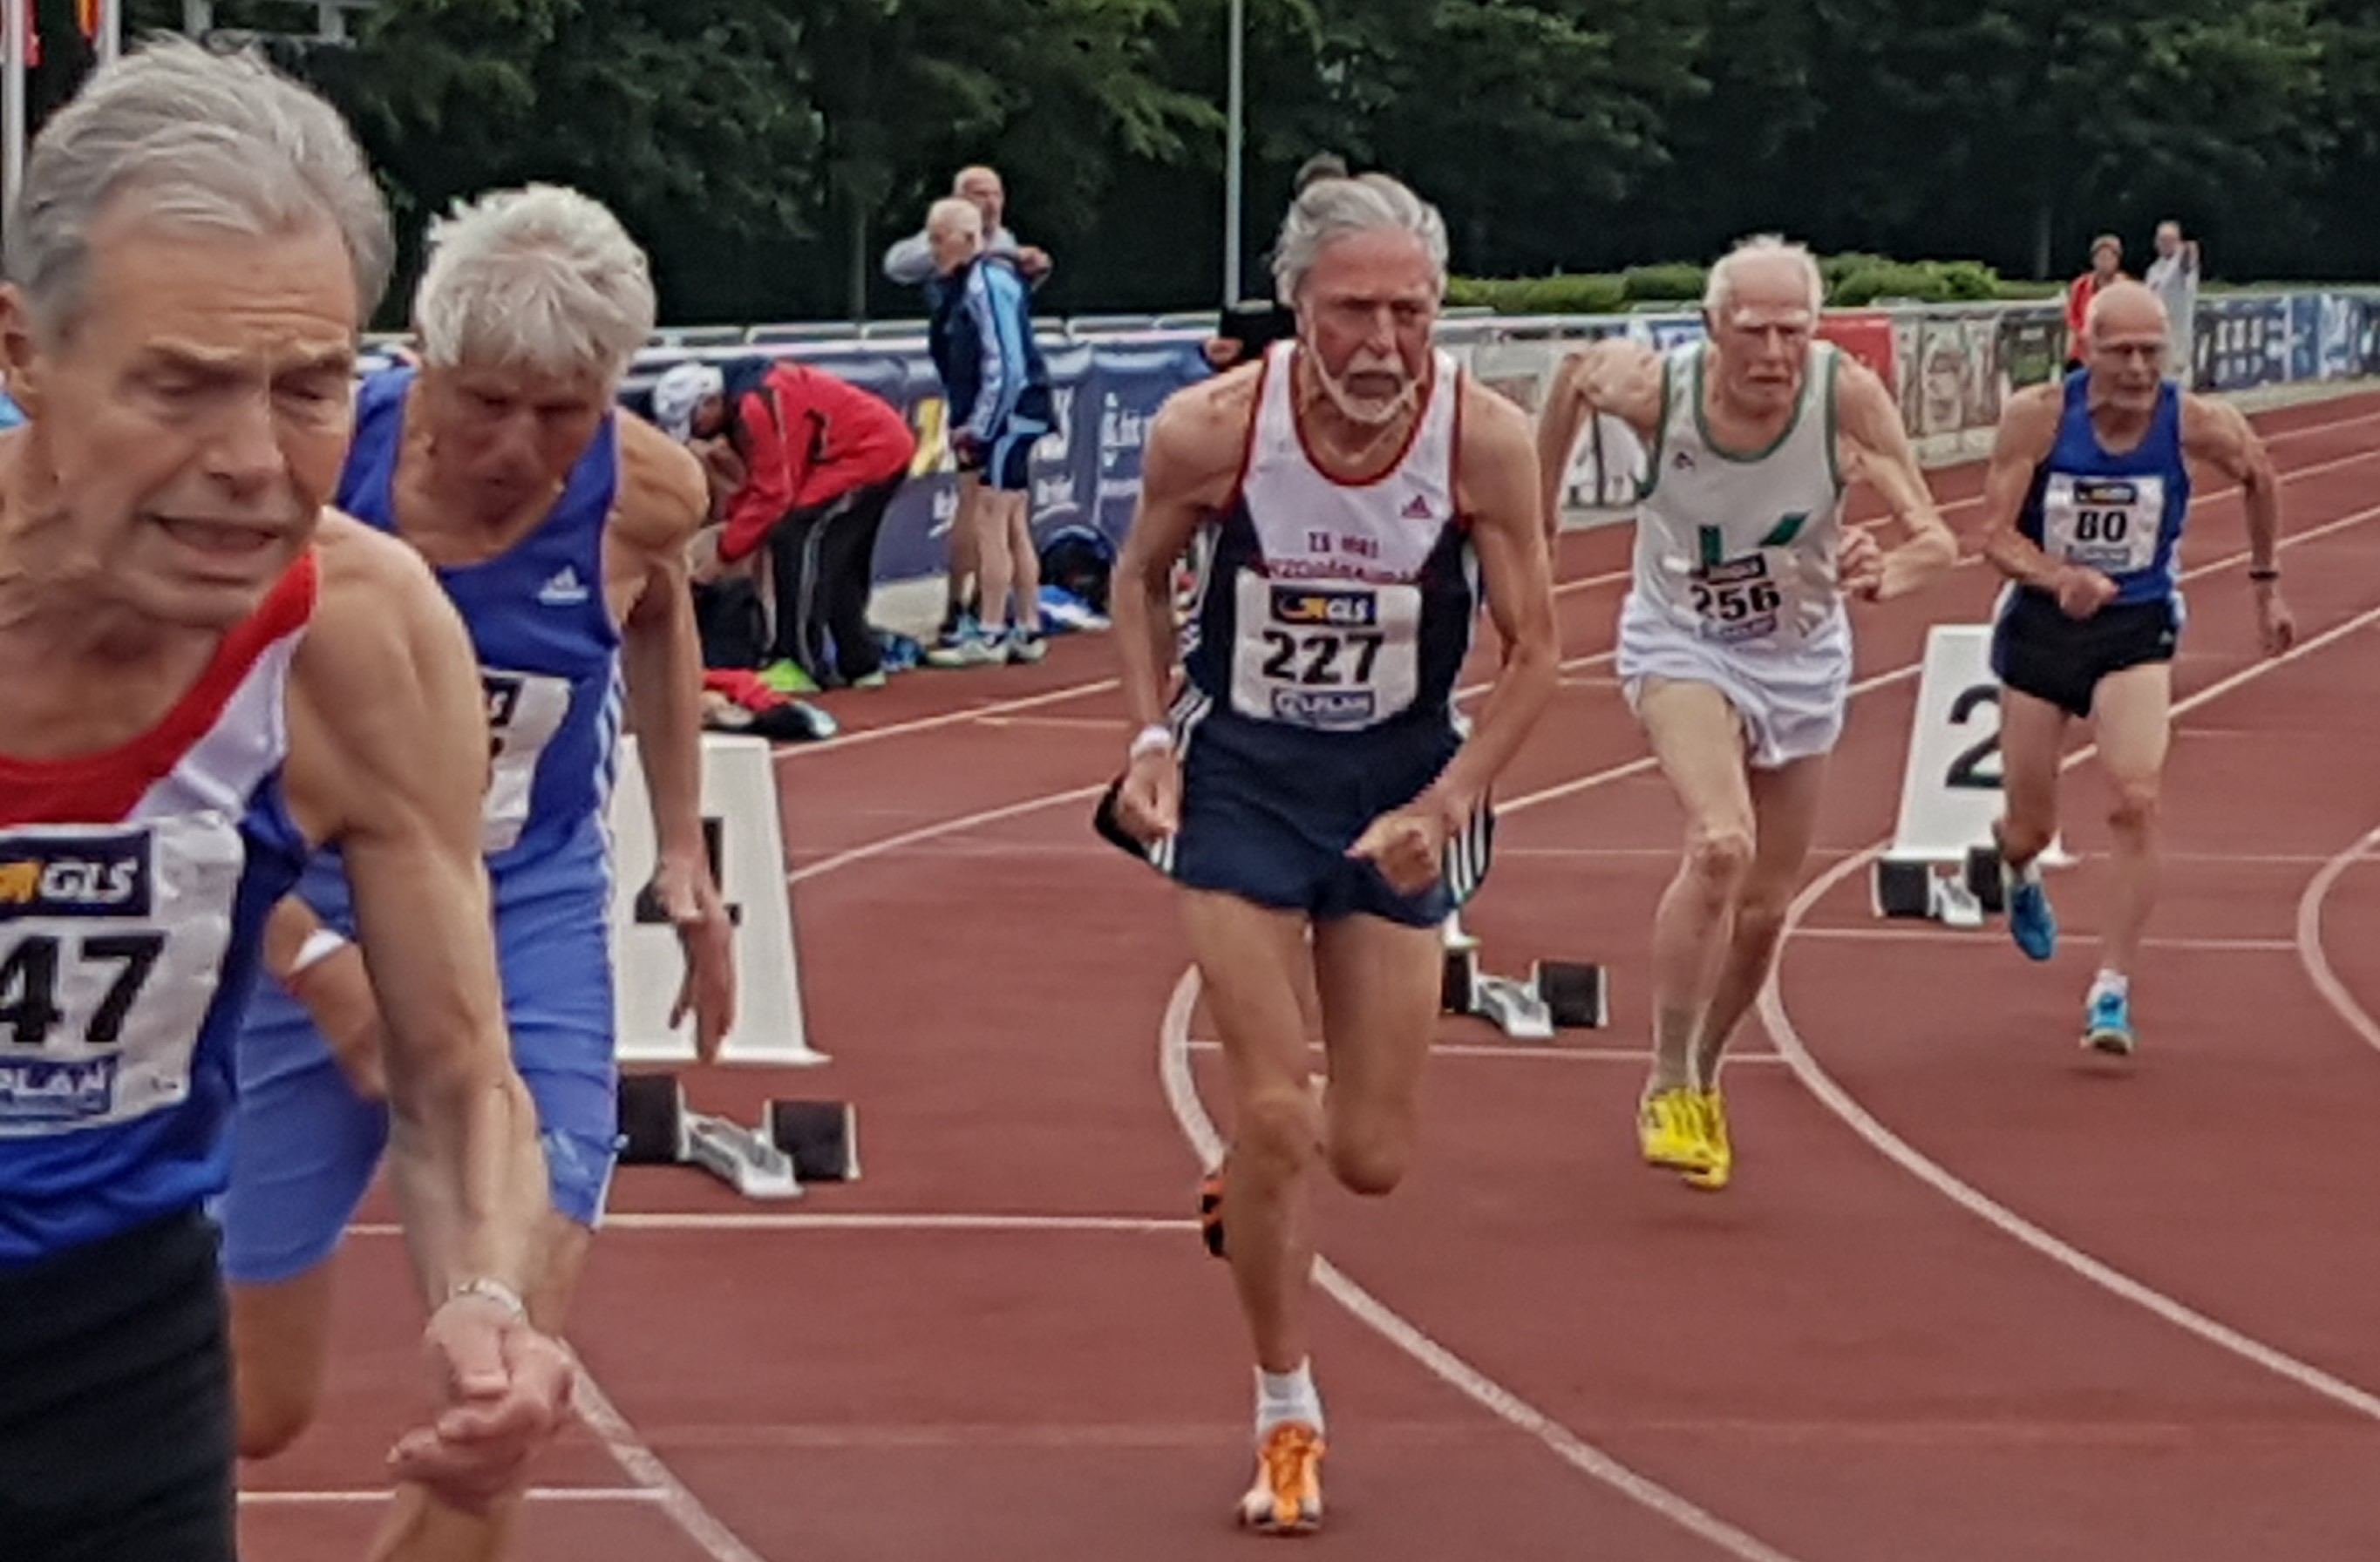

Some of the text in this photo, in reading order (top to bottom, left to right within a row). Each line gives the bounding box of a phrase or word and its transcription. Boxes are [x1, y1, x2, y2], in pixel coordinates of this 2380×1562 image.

[2075, 510, 2127, 542] 80
[1690, 581, 1781, 621] 256
[1262, 629, 1384, 685] 227
[1944, 683, 2003, 790] 2
[41, 857, 138, 904] GLS
